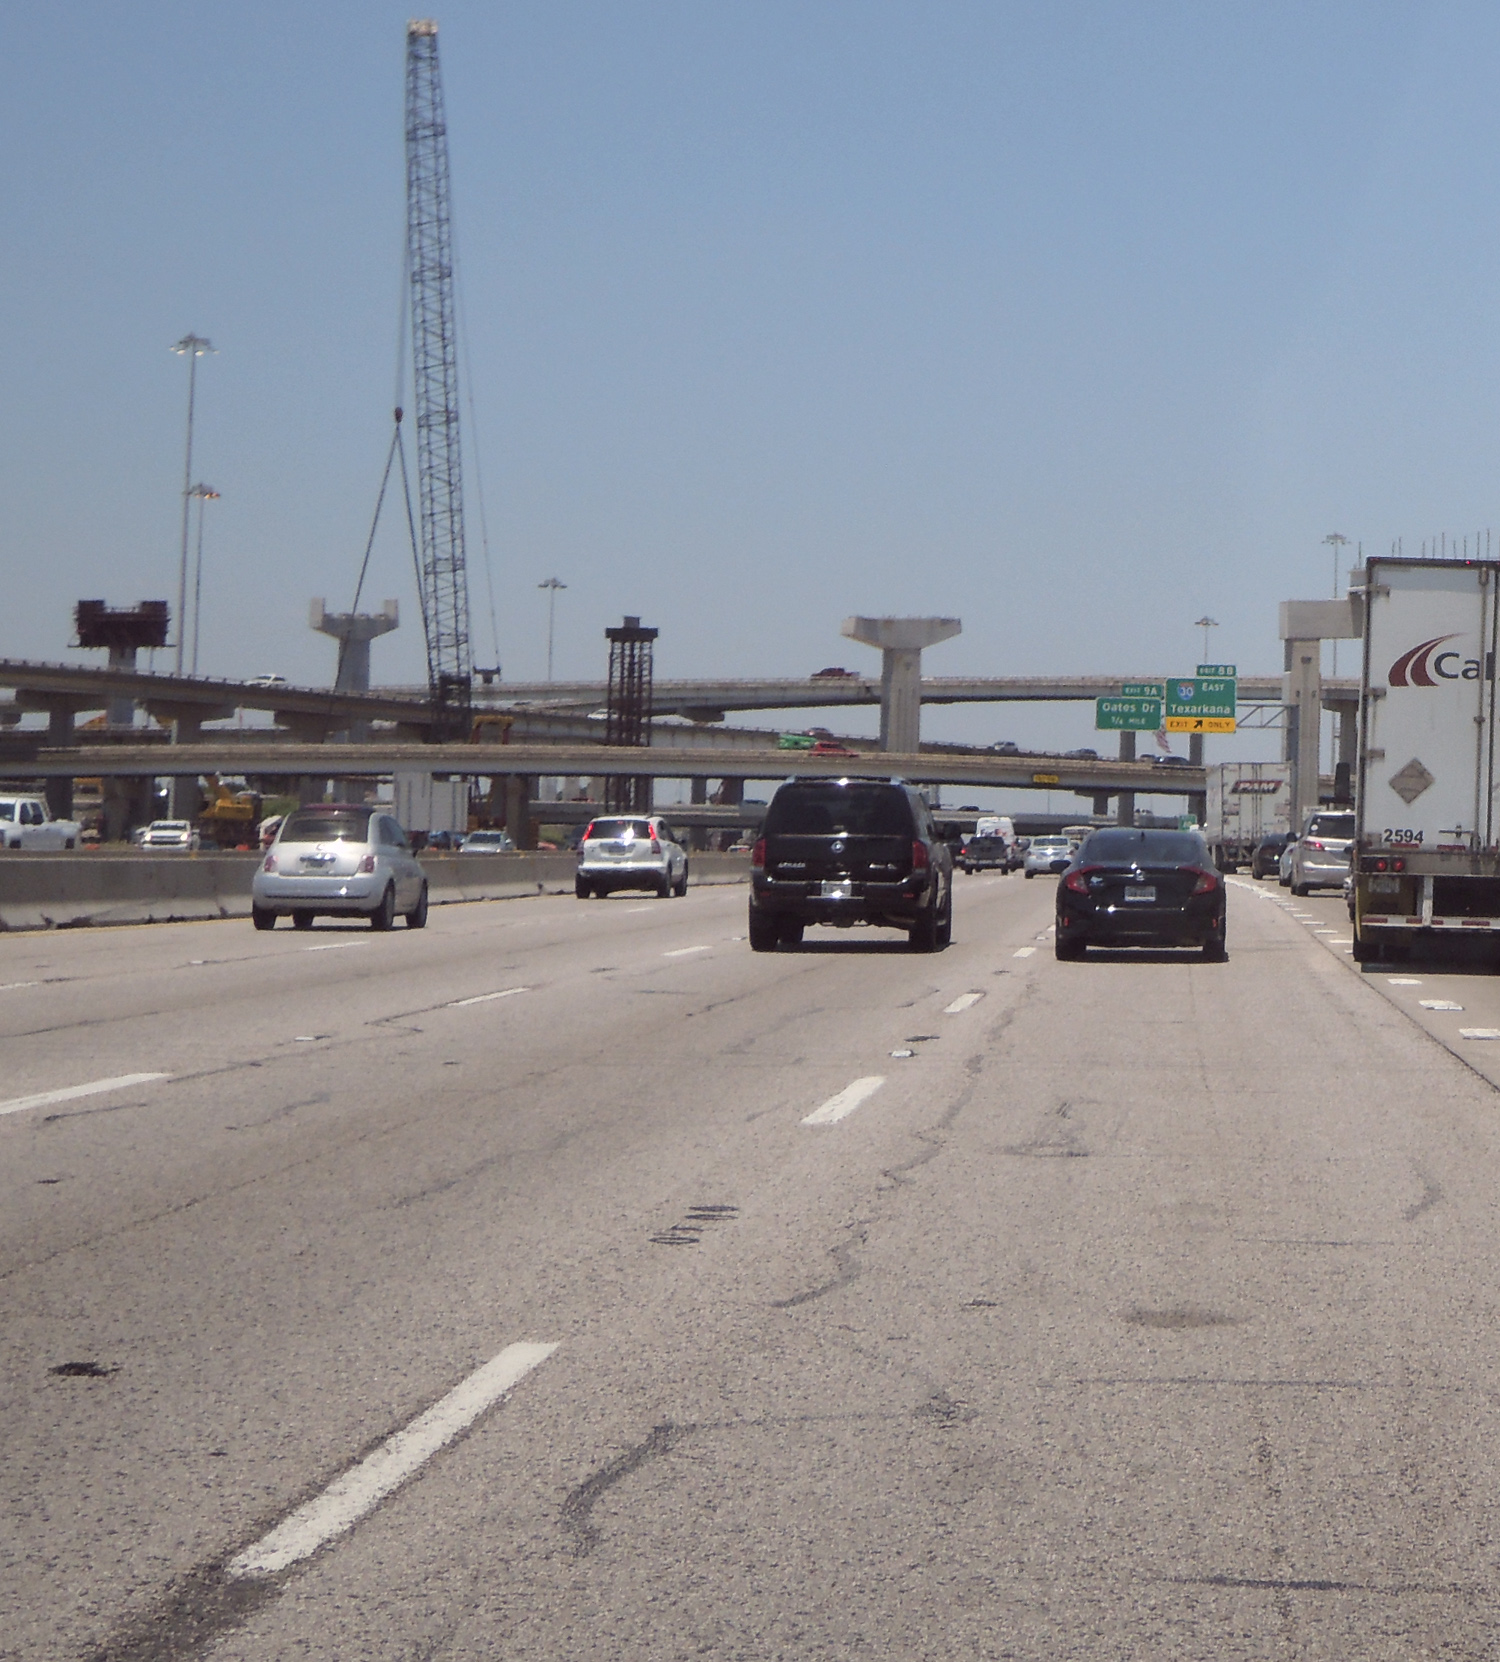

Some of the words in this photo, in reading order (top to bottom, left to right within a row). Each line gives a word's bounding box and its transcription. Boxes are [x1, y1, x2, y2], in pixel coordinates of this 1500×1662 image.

[1144, 686, 1158, 695] 9A
[1180, 686, 1194, 697] 30
[1102, 703, 1136, 713] Oates
[1142, 703, 1155, 713] Dr
[1170, 704, 1231, 714] Texarkana
[1383, 828, 1424, 844] 2594
